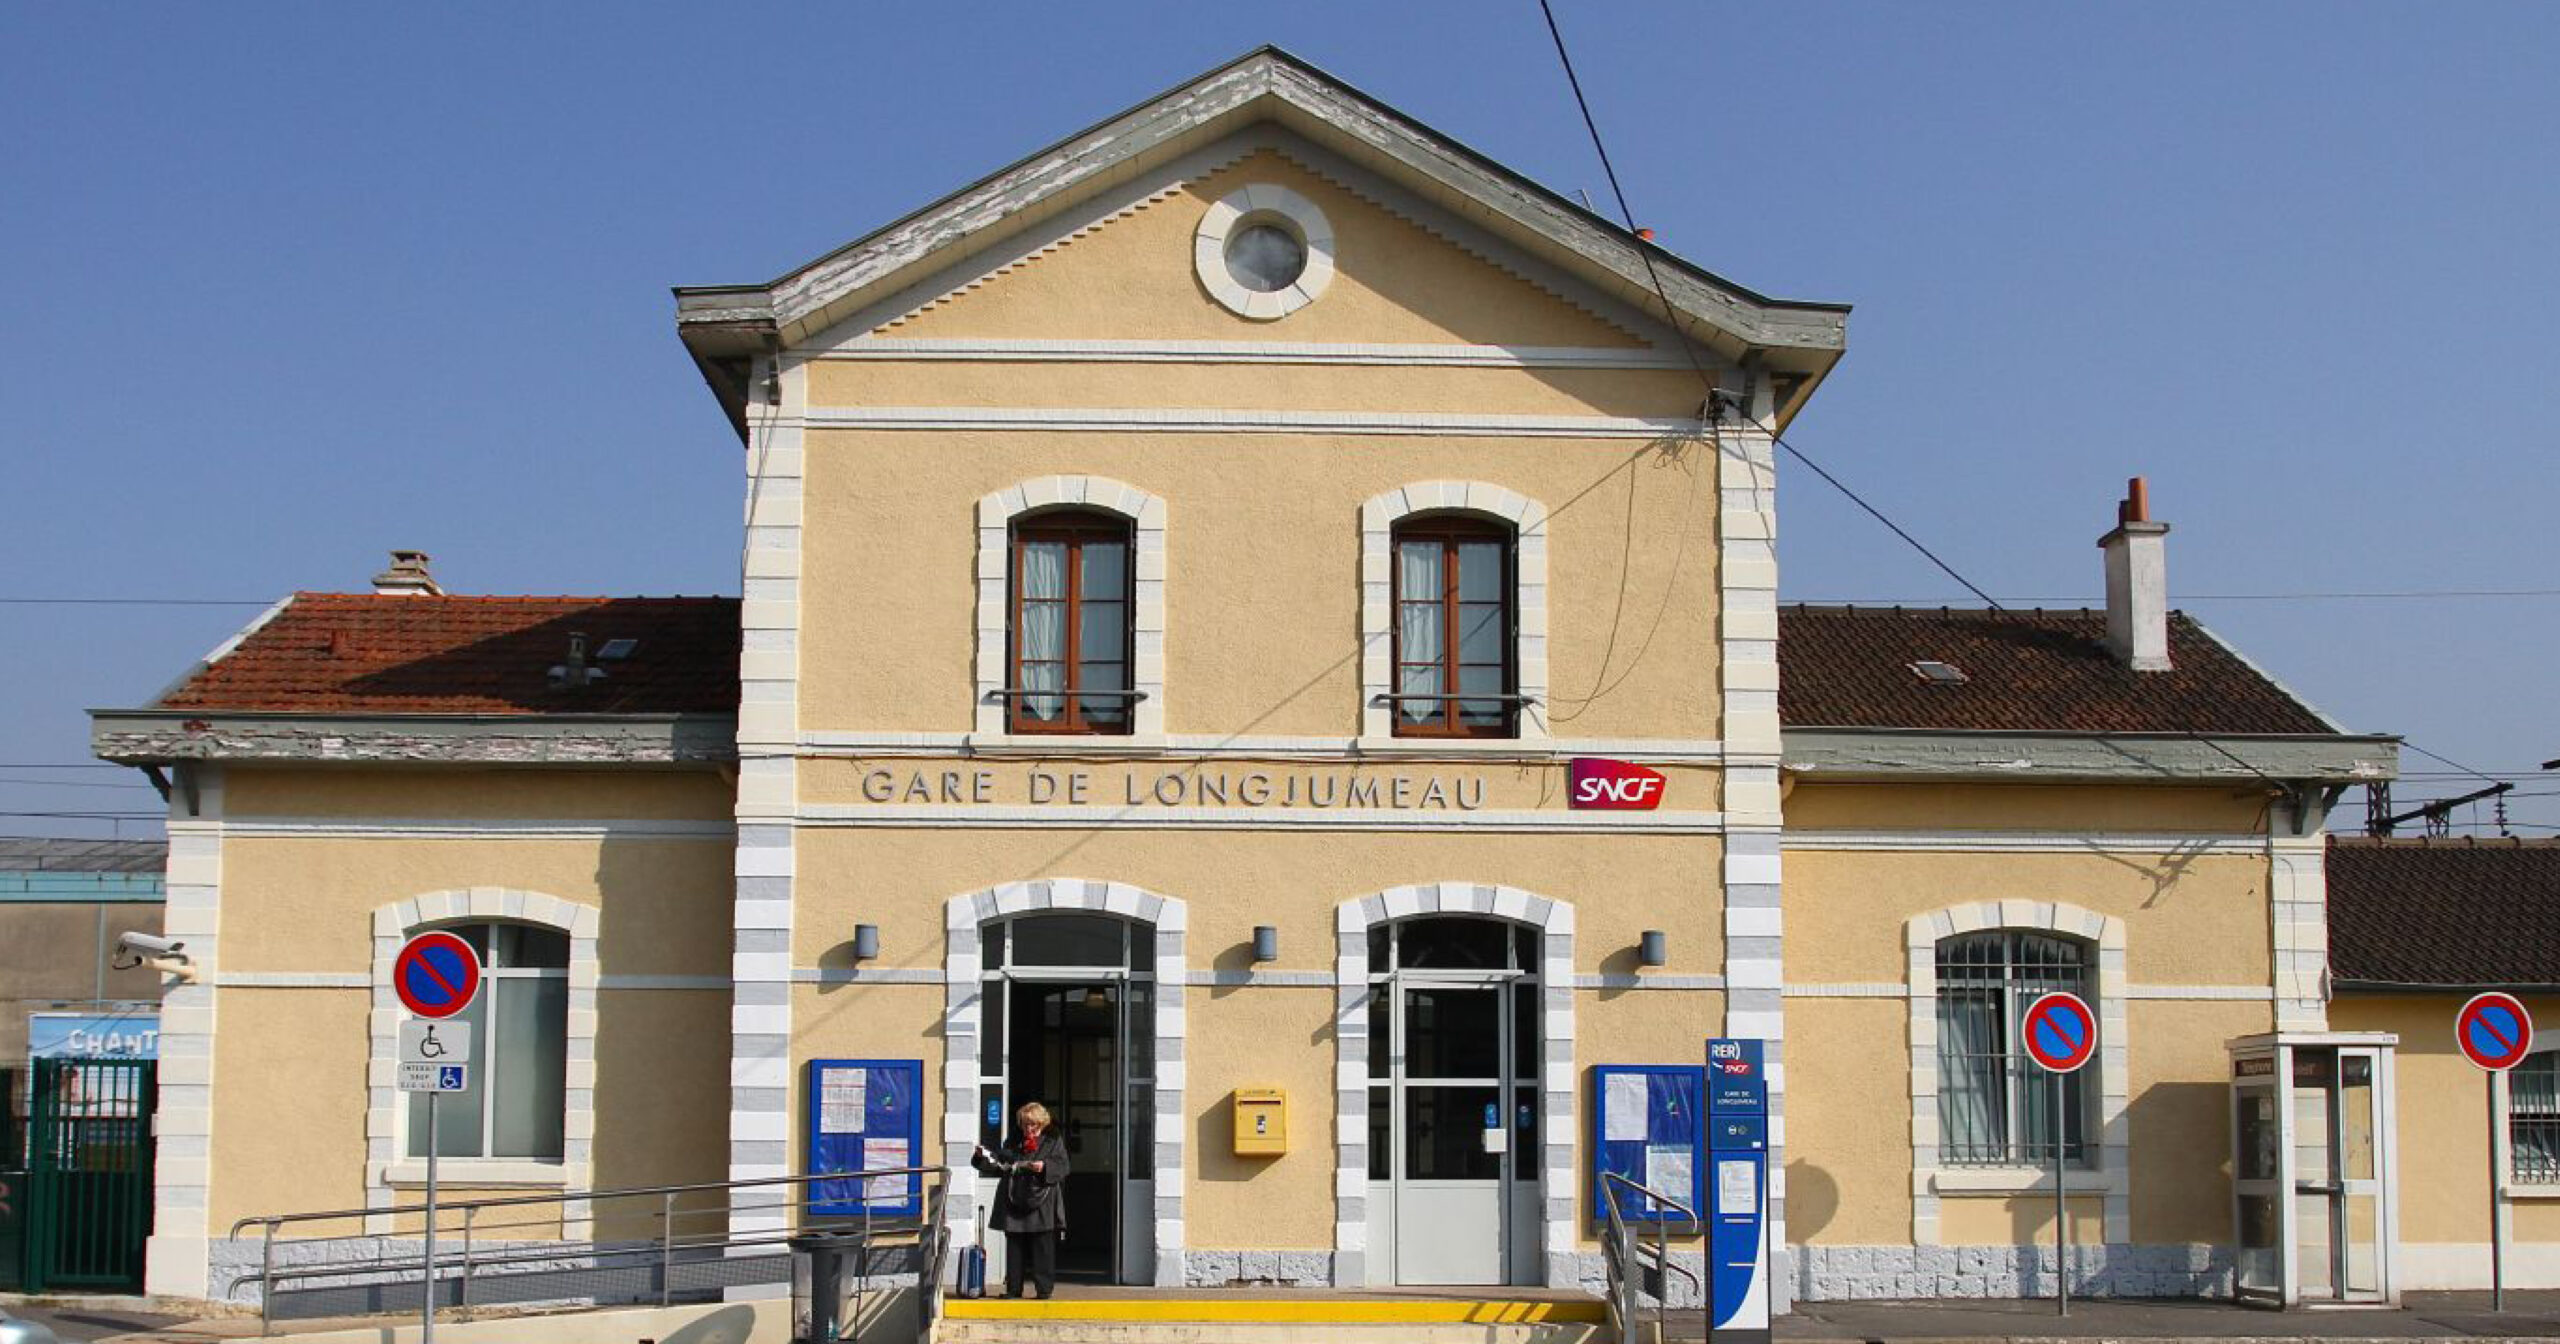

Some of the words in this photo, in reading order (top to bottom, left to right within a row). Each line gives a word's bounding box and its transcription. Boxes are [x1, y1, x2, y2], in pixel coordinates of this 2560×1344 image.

[861, 771, 994, 803] GARE
[1029, 773, 1088, 805] DE
[1126, 772, 1487, 811] LONGJUMEAU
[1576, 777, 1660, 801] SNCF
[1724, 1064, 1749, 1074] SNCF
